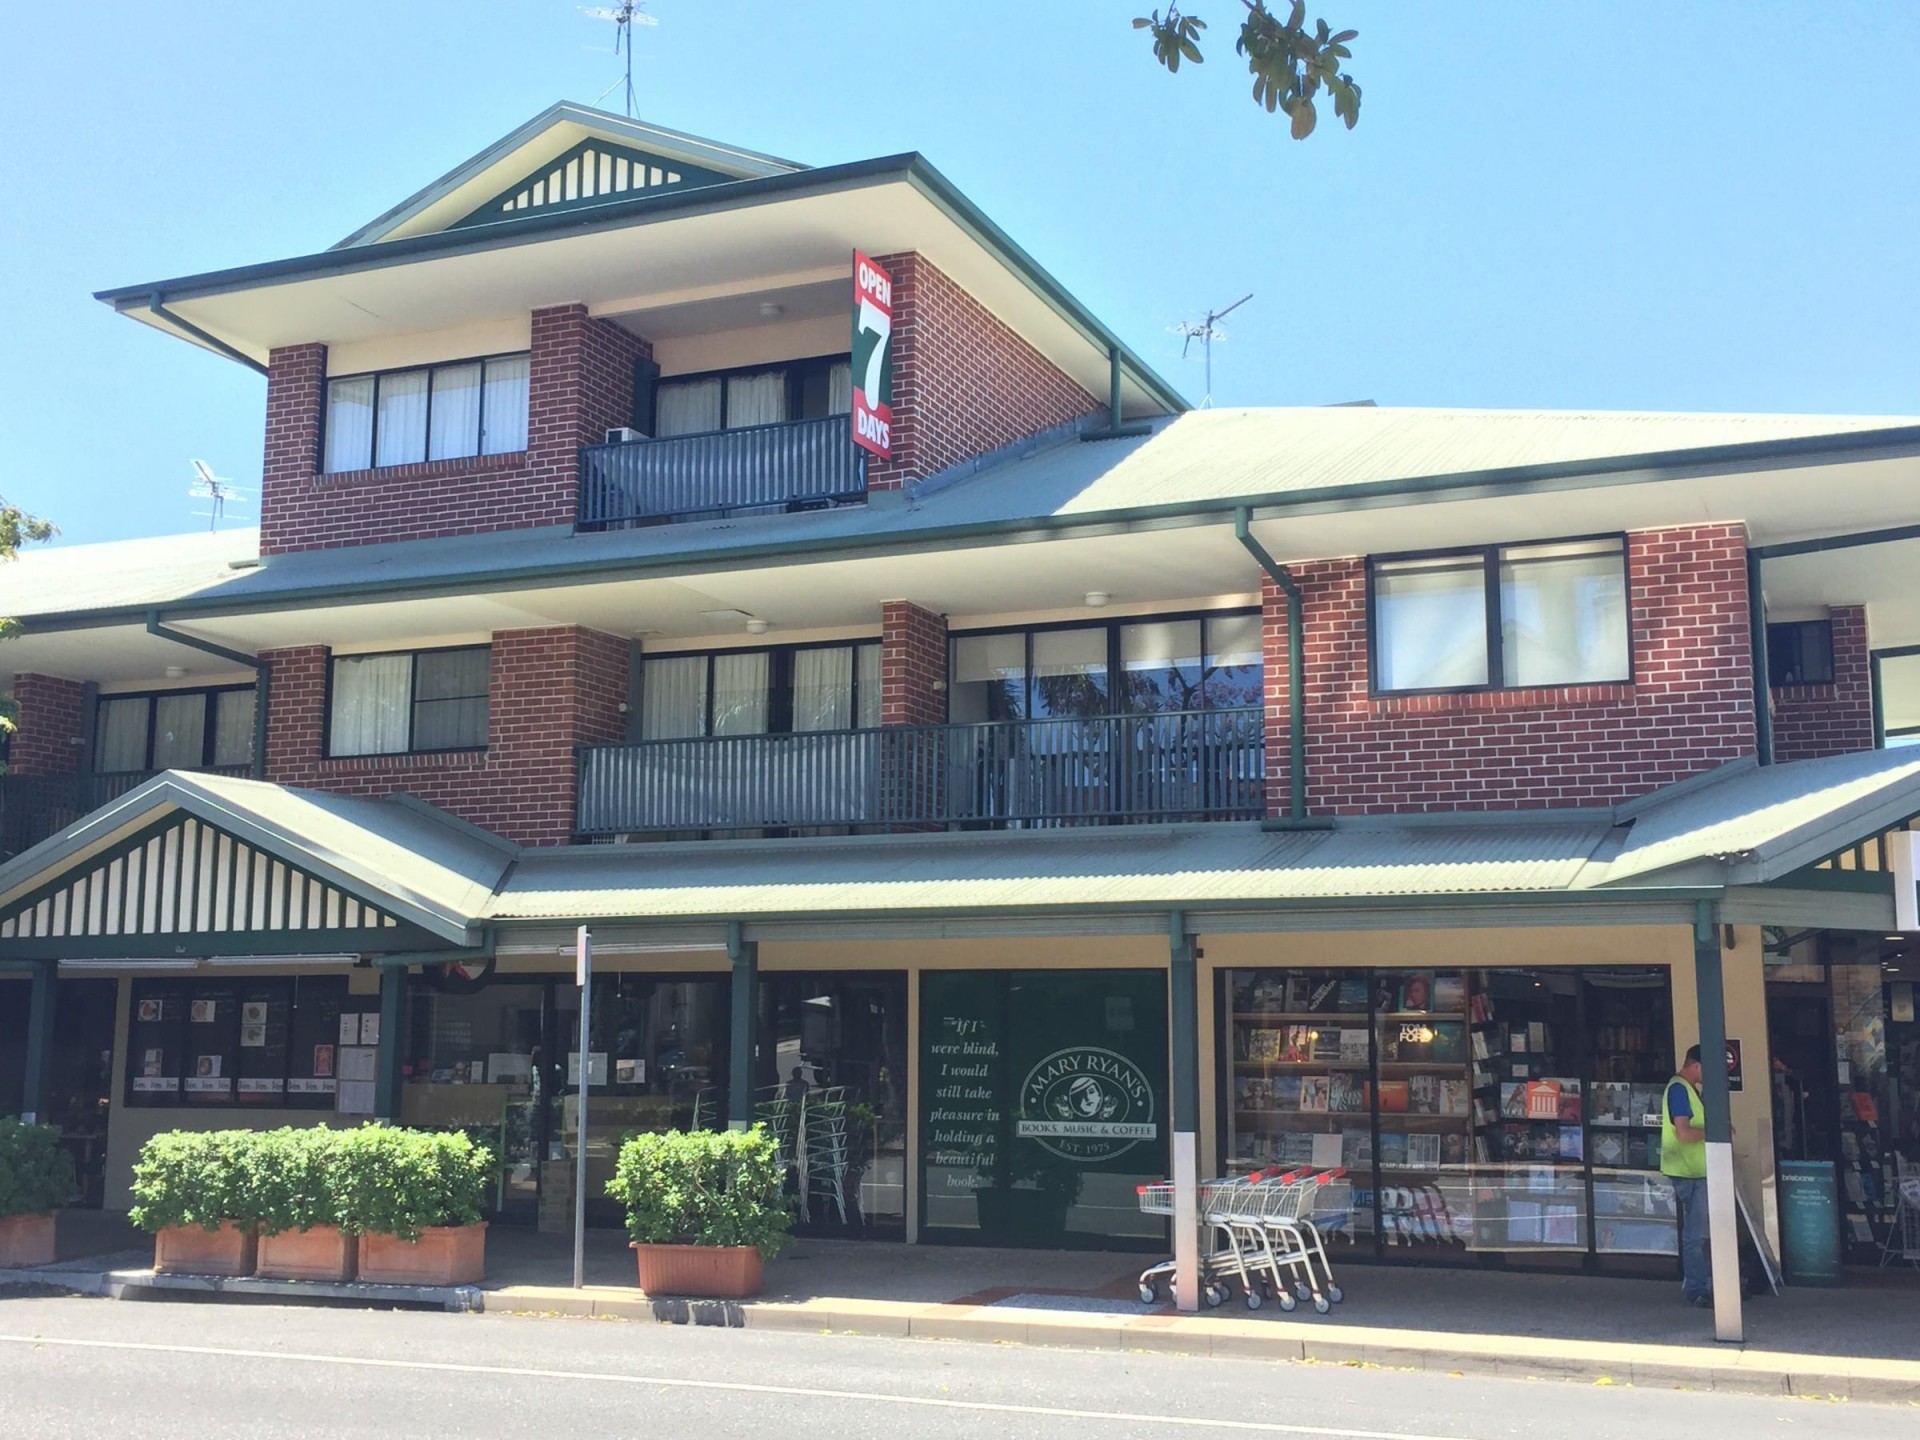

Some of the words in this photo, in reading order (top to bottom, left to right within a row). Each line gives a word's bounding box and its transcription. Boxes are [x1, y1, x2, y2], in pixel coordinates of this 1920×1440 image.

[858, 262, 891, 308] OPEN
[858, 295, 891, 412] 7
[857, 407, 890, 449] DAYS
[1400, 1023, 1427, 1034] TOM
[1400, 1032, 1433, 1043] FOR
[931, 1044, 960, 1054] were
[962, 1041, 999, 1057] blind,
[941, 1063, 948, 1076] I
[951, 1063, 989, 1077] would
[1030, 1055, 1084, 1095] MARY
[1086, 1055, 1146, 1099] RYAN'S
[936, 1084, 961, 1099] still
[964, 1085, 993, 1099] take
[930, 1107, 984, 1123] pleasure
[987, 1108, 1000, 1121] in
[934, 1129, 984, 1146] holding
[985, 1134, 995, 1144] a
[1063, 1124, 1098, 1135] MUSIC
[1100, 1124, 1110, 1135] &
[1112, 1125, 1154, 1136] COFFEE
[935, 1152, 995, 1168] beautiful
